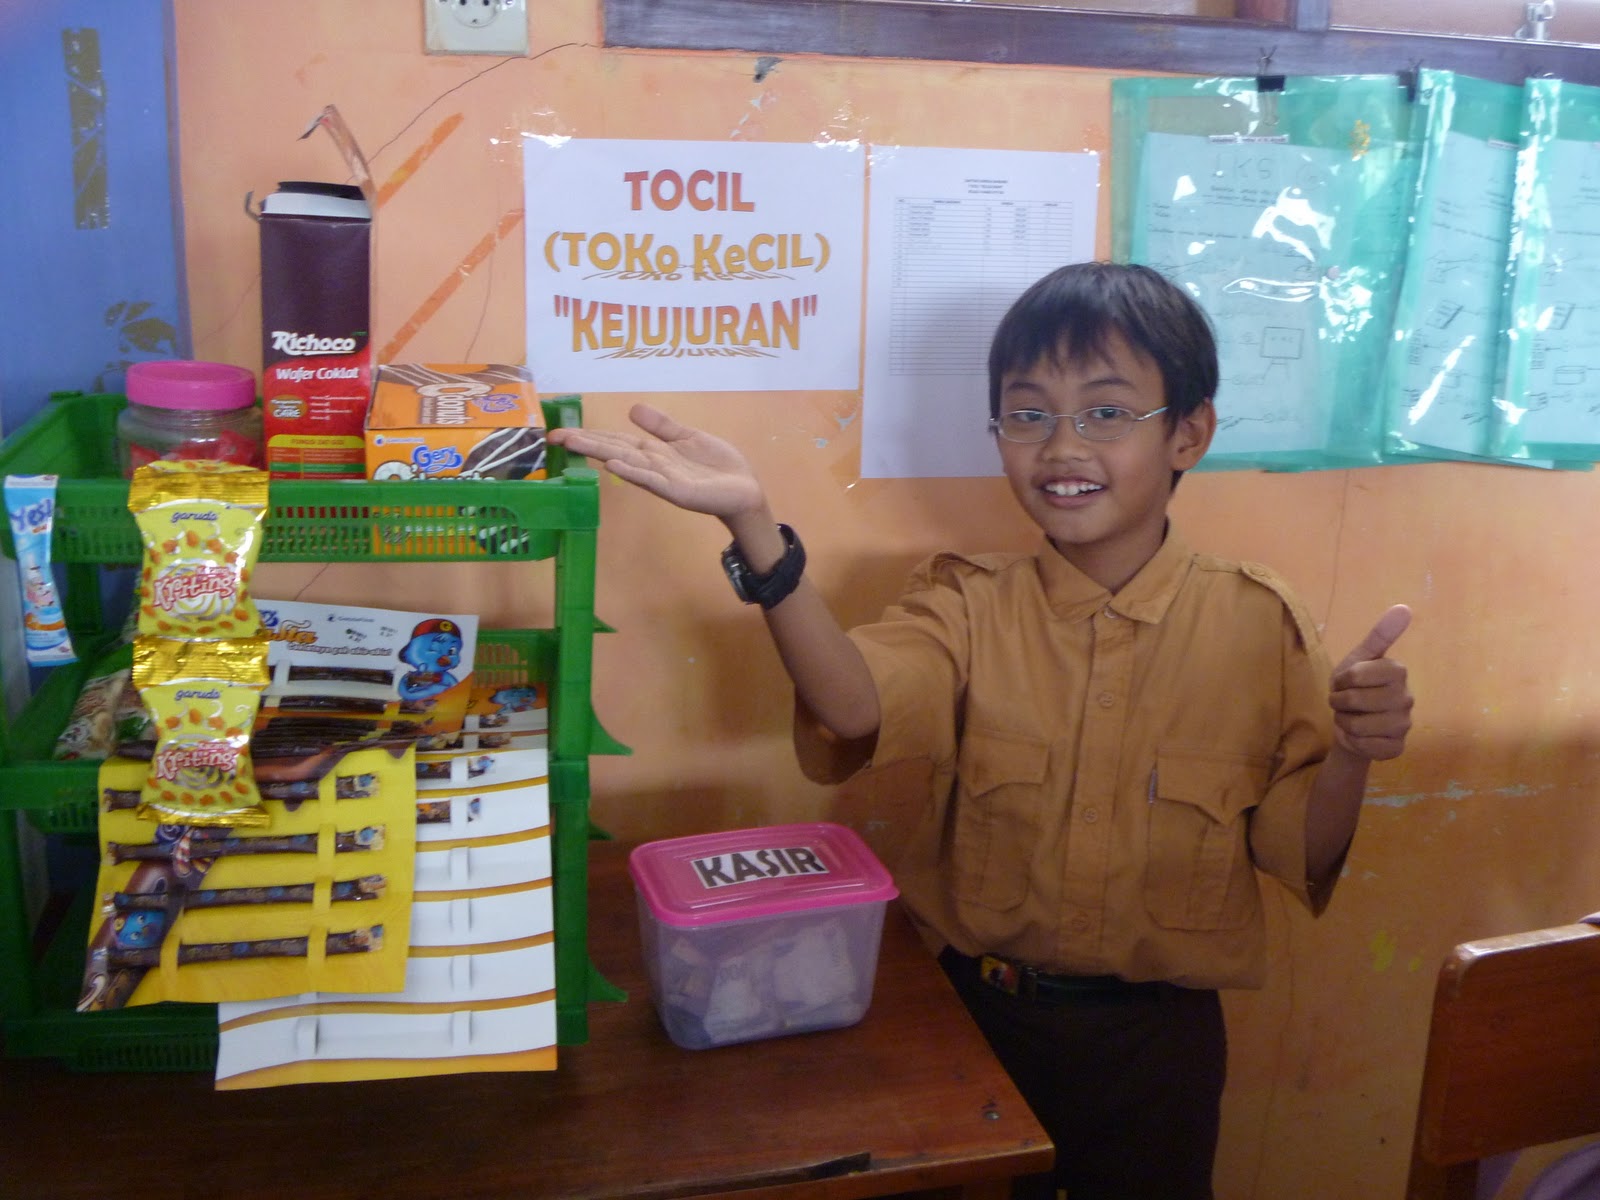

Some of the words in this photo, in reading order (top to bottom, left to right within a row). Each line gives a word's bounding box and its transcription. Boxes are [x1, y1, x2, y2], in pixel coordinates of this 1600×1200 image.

[624, 169, 755, 212] TOCIL
[544, 231, 679, 273] (TOKo
[693, 232, 831, 274] KeCIL)
[554, 294, 818, 352] "KEJUJURAN"
[271, 331, 357, 356] Richoco
[276, 367, 315, 382] Wafer
[317, 367, 360, 380] Coklat
[171, 511, 219, 523] garuda
[175, 689, 221, 700] garuda
[695, 847, 825, 889] KASIR
